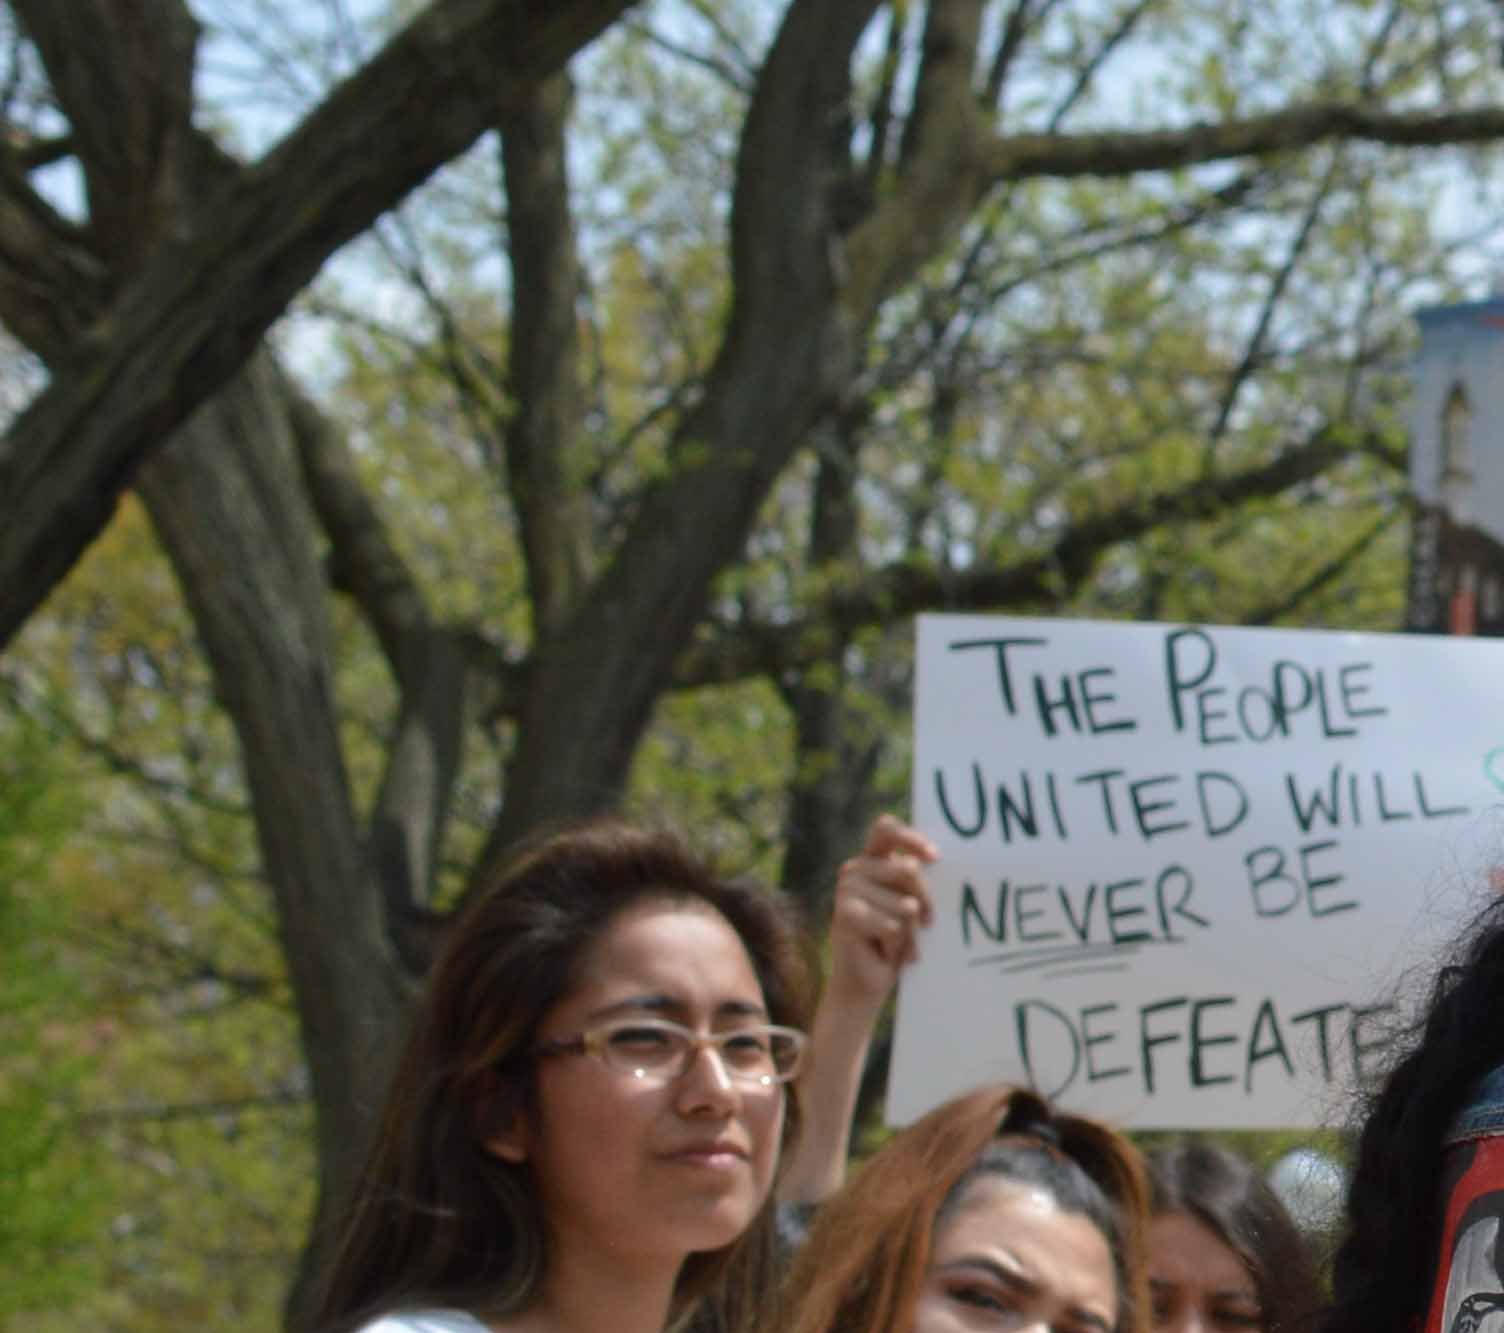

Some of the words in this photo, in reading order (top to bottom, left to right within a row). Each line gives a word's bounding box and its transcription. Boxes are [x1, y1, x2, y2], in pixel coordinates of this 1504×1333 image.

[947, 636, 1138, 737] THE
[1163, 629, 1386, 747] PEOPLE
[934, 768, 1249, 845] UNITED
[1286, 763, 1470, 836] WILL
[960, 865, 1211, 948] NEVER
[1246, 841, 1361, 919] BE
[1015, 996, 1400, 1101] DEFEATE
